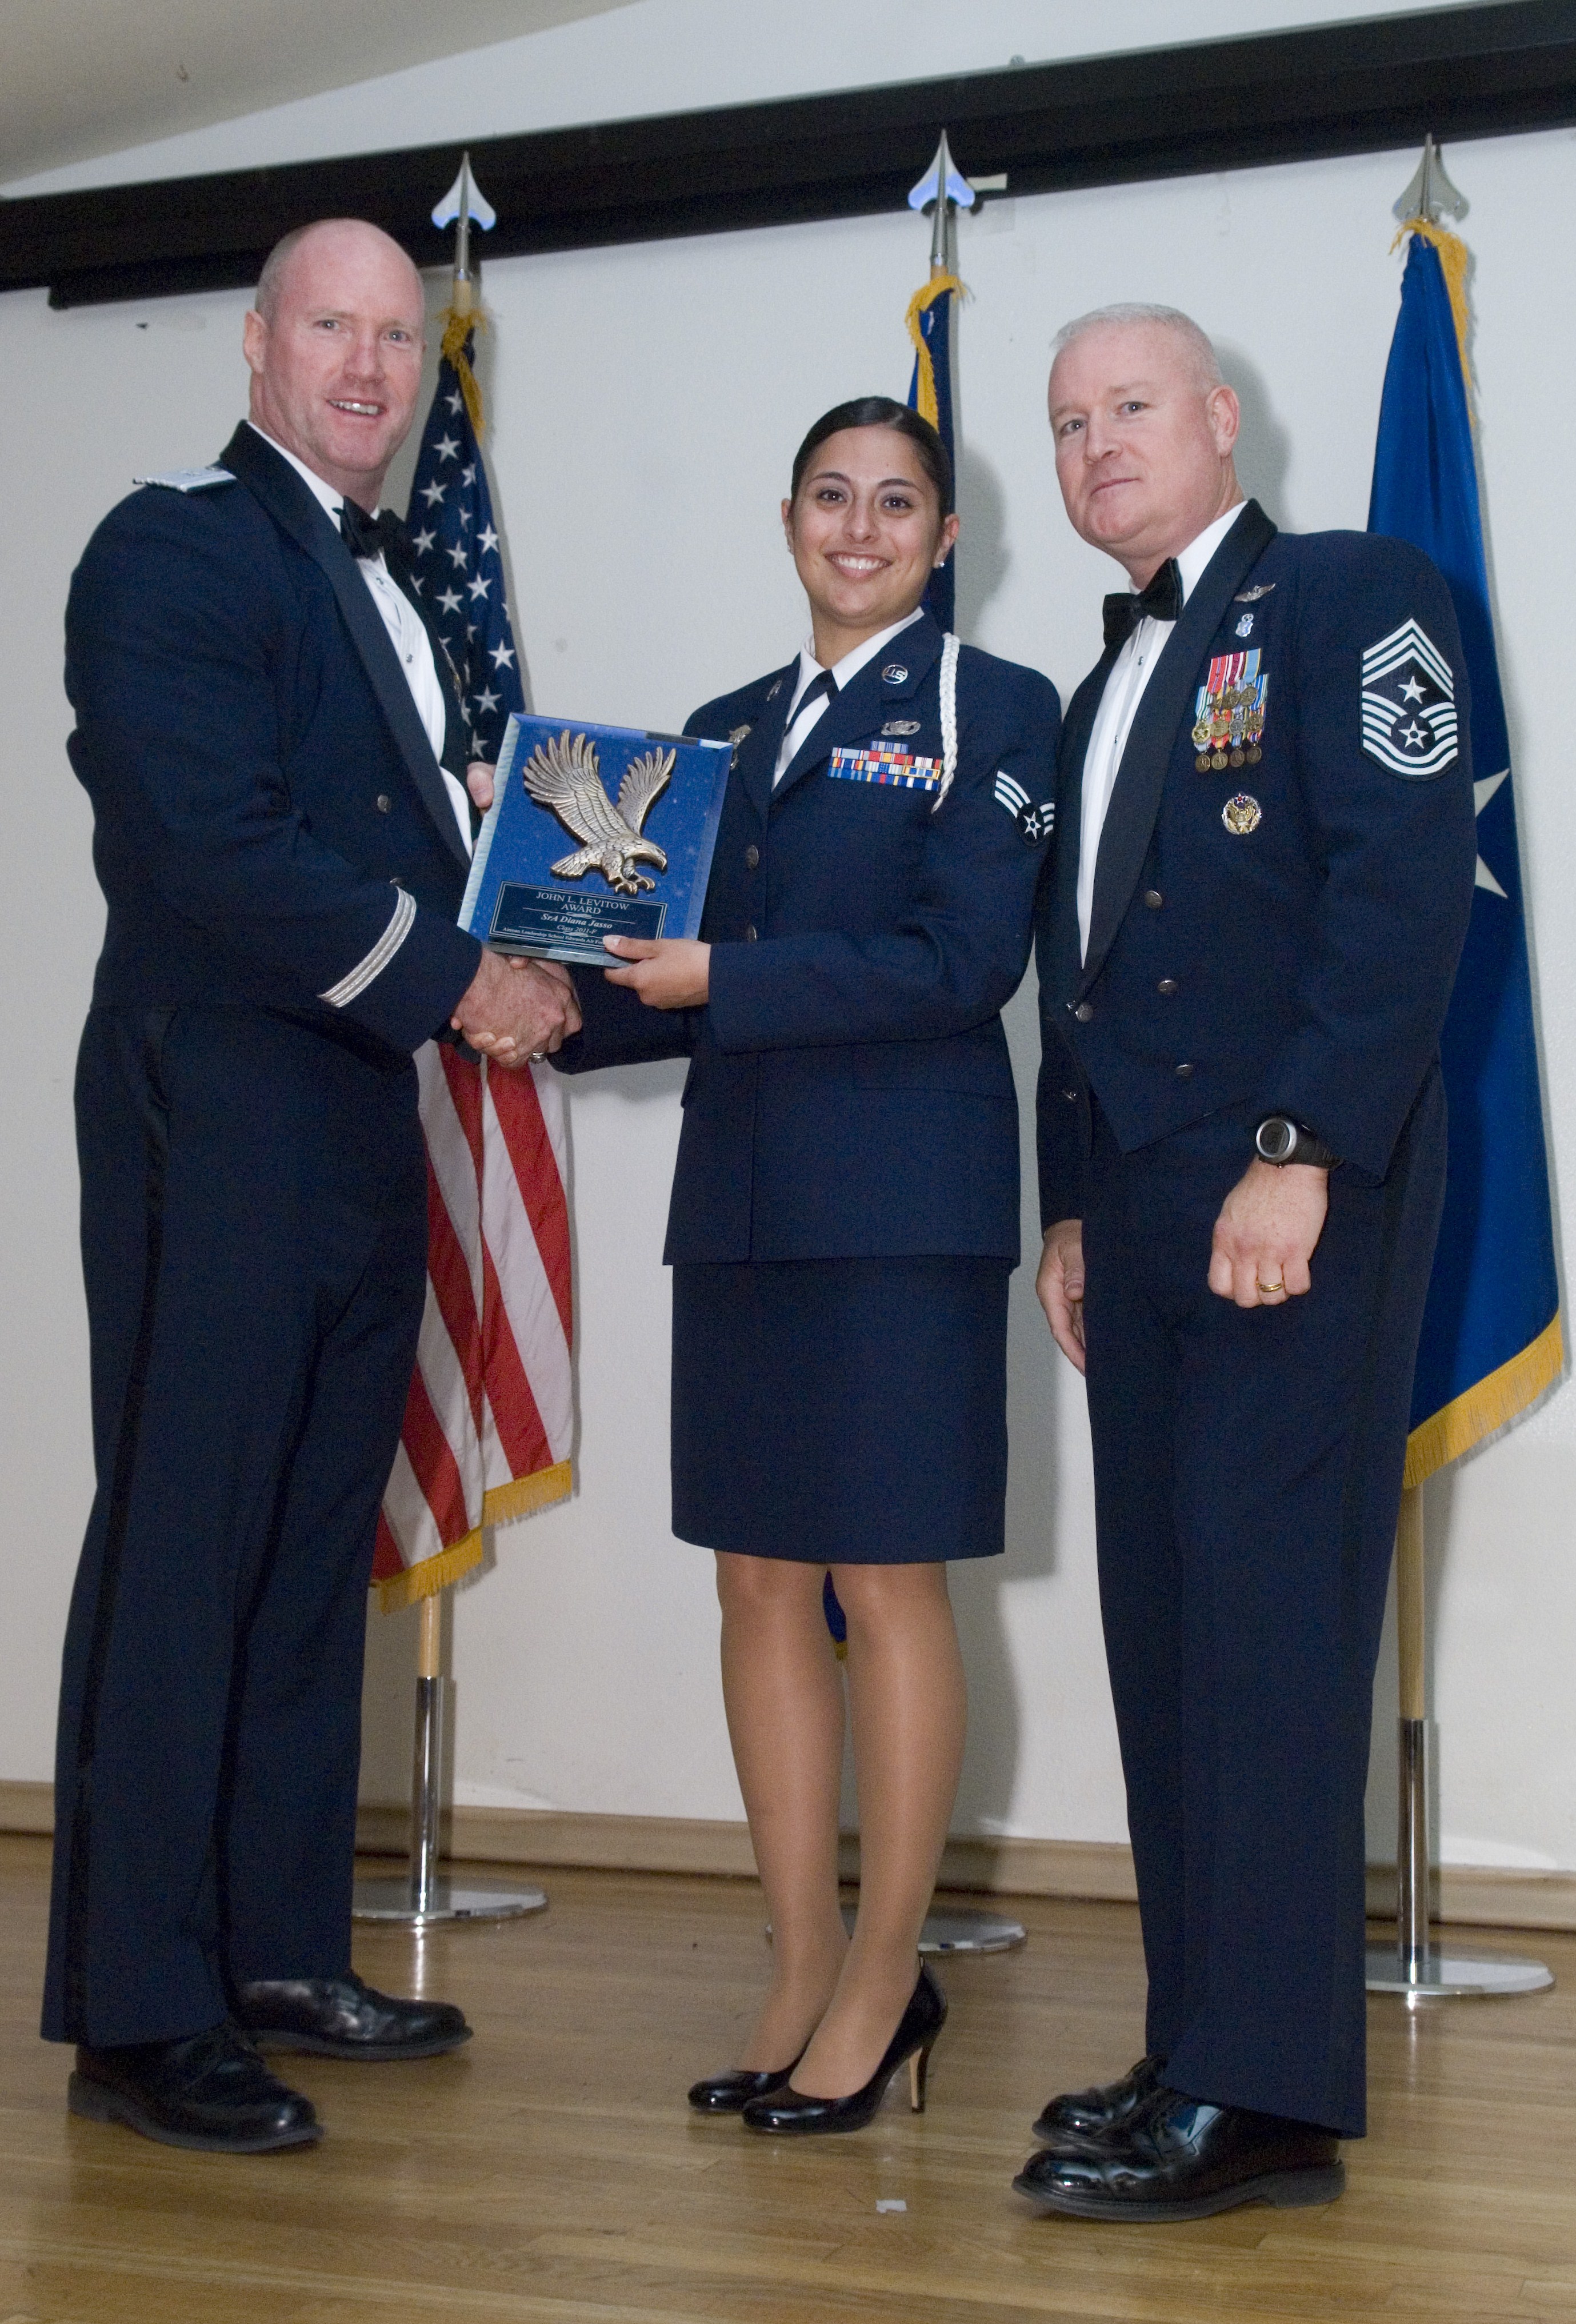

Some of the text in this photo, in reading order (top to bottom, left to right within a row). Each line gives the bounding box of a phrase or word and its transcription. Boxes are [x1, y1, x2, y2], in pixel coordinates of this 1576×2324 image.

[536, 892, 565, 902] JOHN
[579, 897, 630, 911] LEVITOW
[561, 904, 601, 915] AWARD
[541, 913, 613, 929] SrA Diana Jasso
